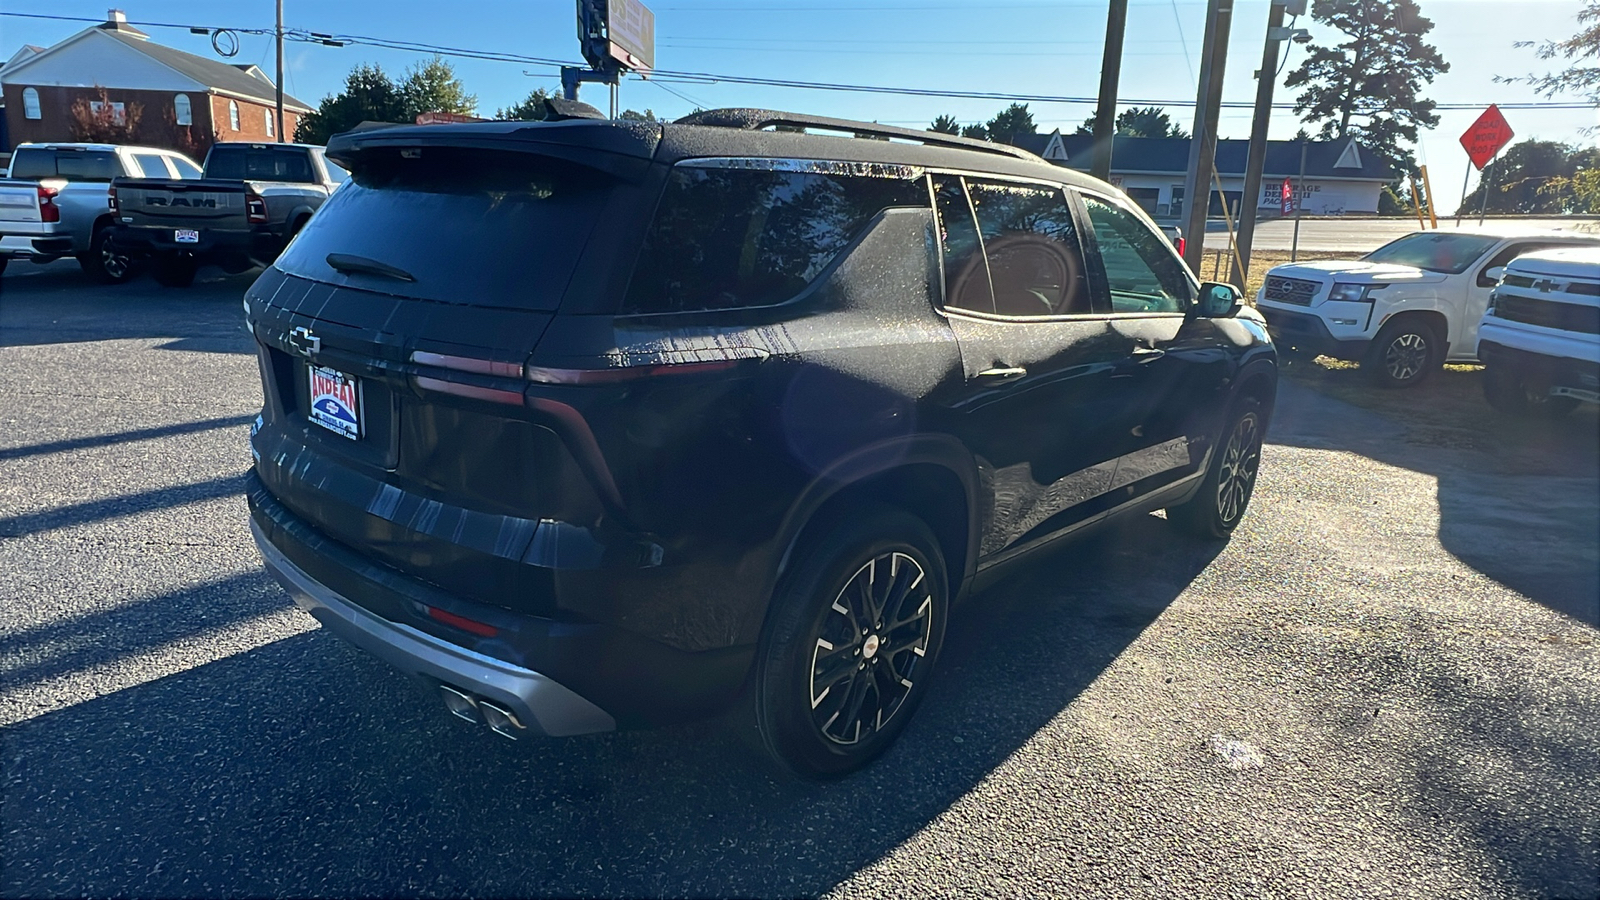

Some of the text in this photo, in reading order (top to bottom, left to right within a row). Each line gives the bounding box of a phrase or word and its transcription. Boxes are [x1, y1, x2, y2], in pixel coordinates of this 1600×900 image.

[1477, 119, 1500, 129] ROAD
[1475, 132, 1498, 142] WORK
[1265, 183, 1322, 192] BEVRAGE
[145, 196, 217, 209] RAM
[312, 373, 356, 412] ANDEAN
